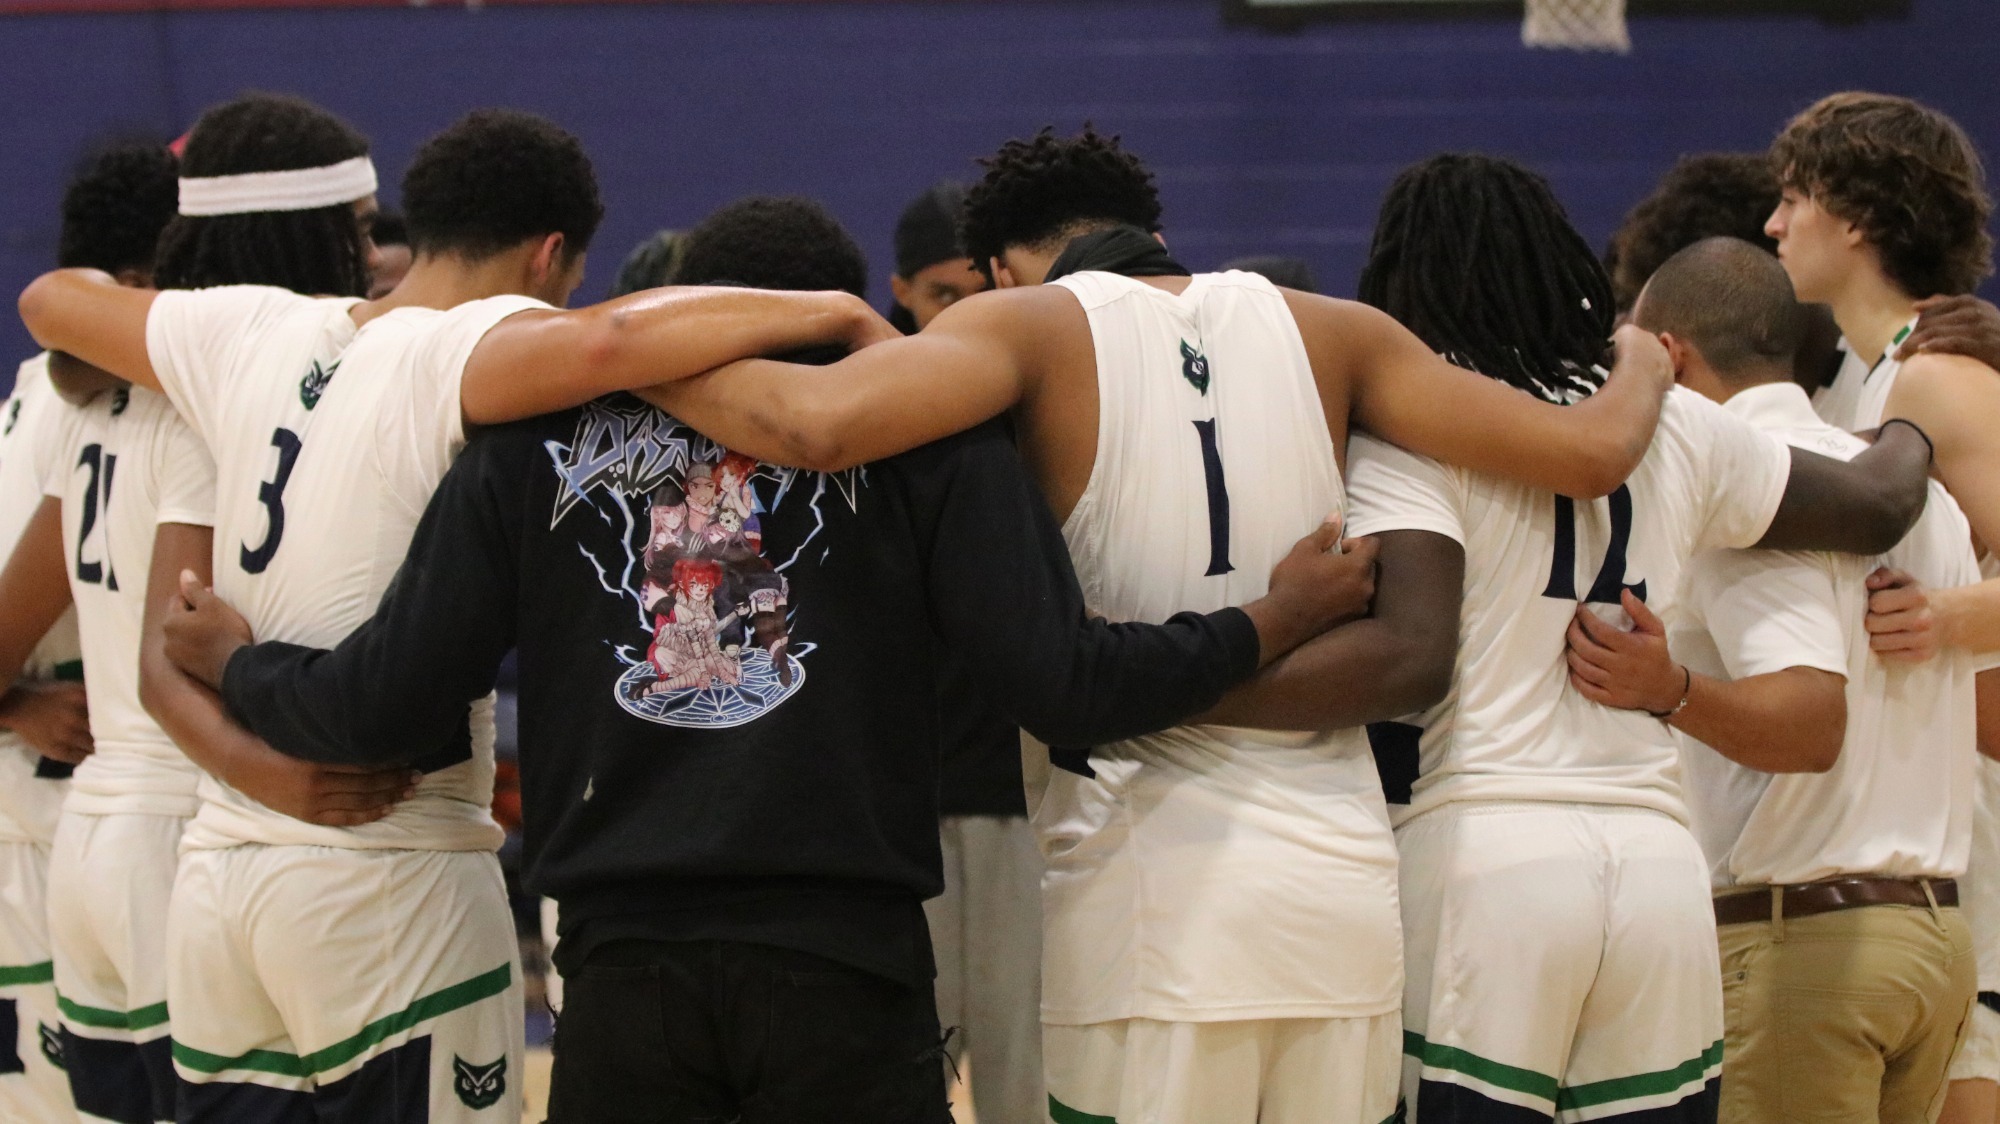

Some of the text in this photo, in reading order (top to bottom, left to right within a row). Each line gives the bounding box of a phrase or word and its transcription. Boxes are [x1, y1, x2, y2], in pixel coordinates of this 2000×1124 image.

[75, 443, 119, 591] 21
[239, 427, 302, 574] 3
[1191, 417, 1236, 577] 1
[1541, 482, 1647, 605] 12
